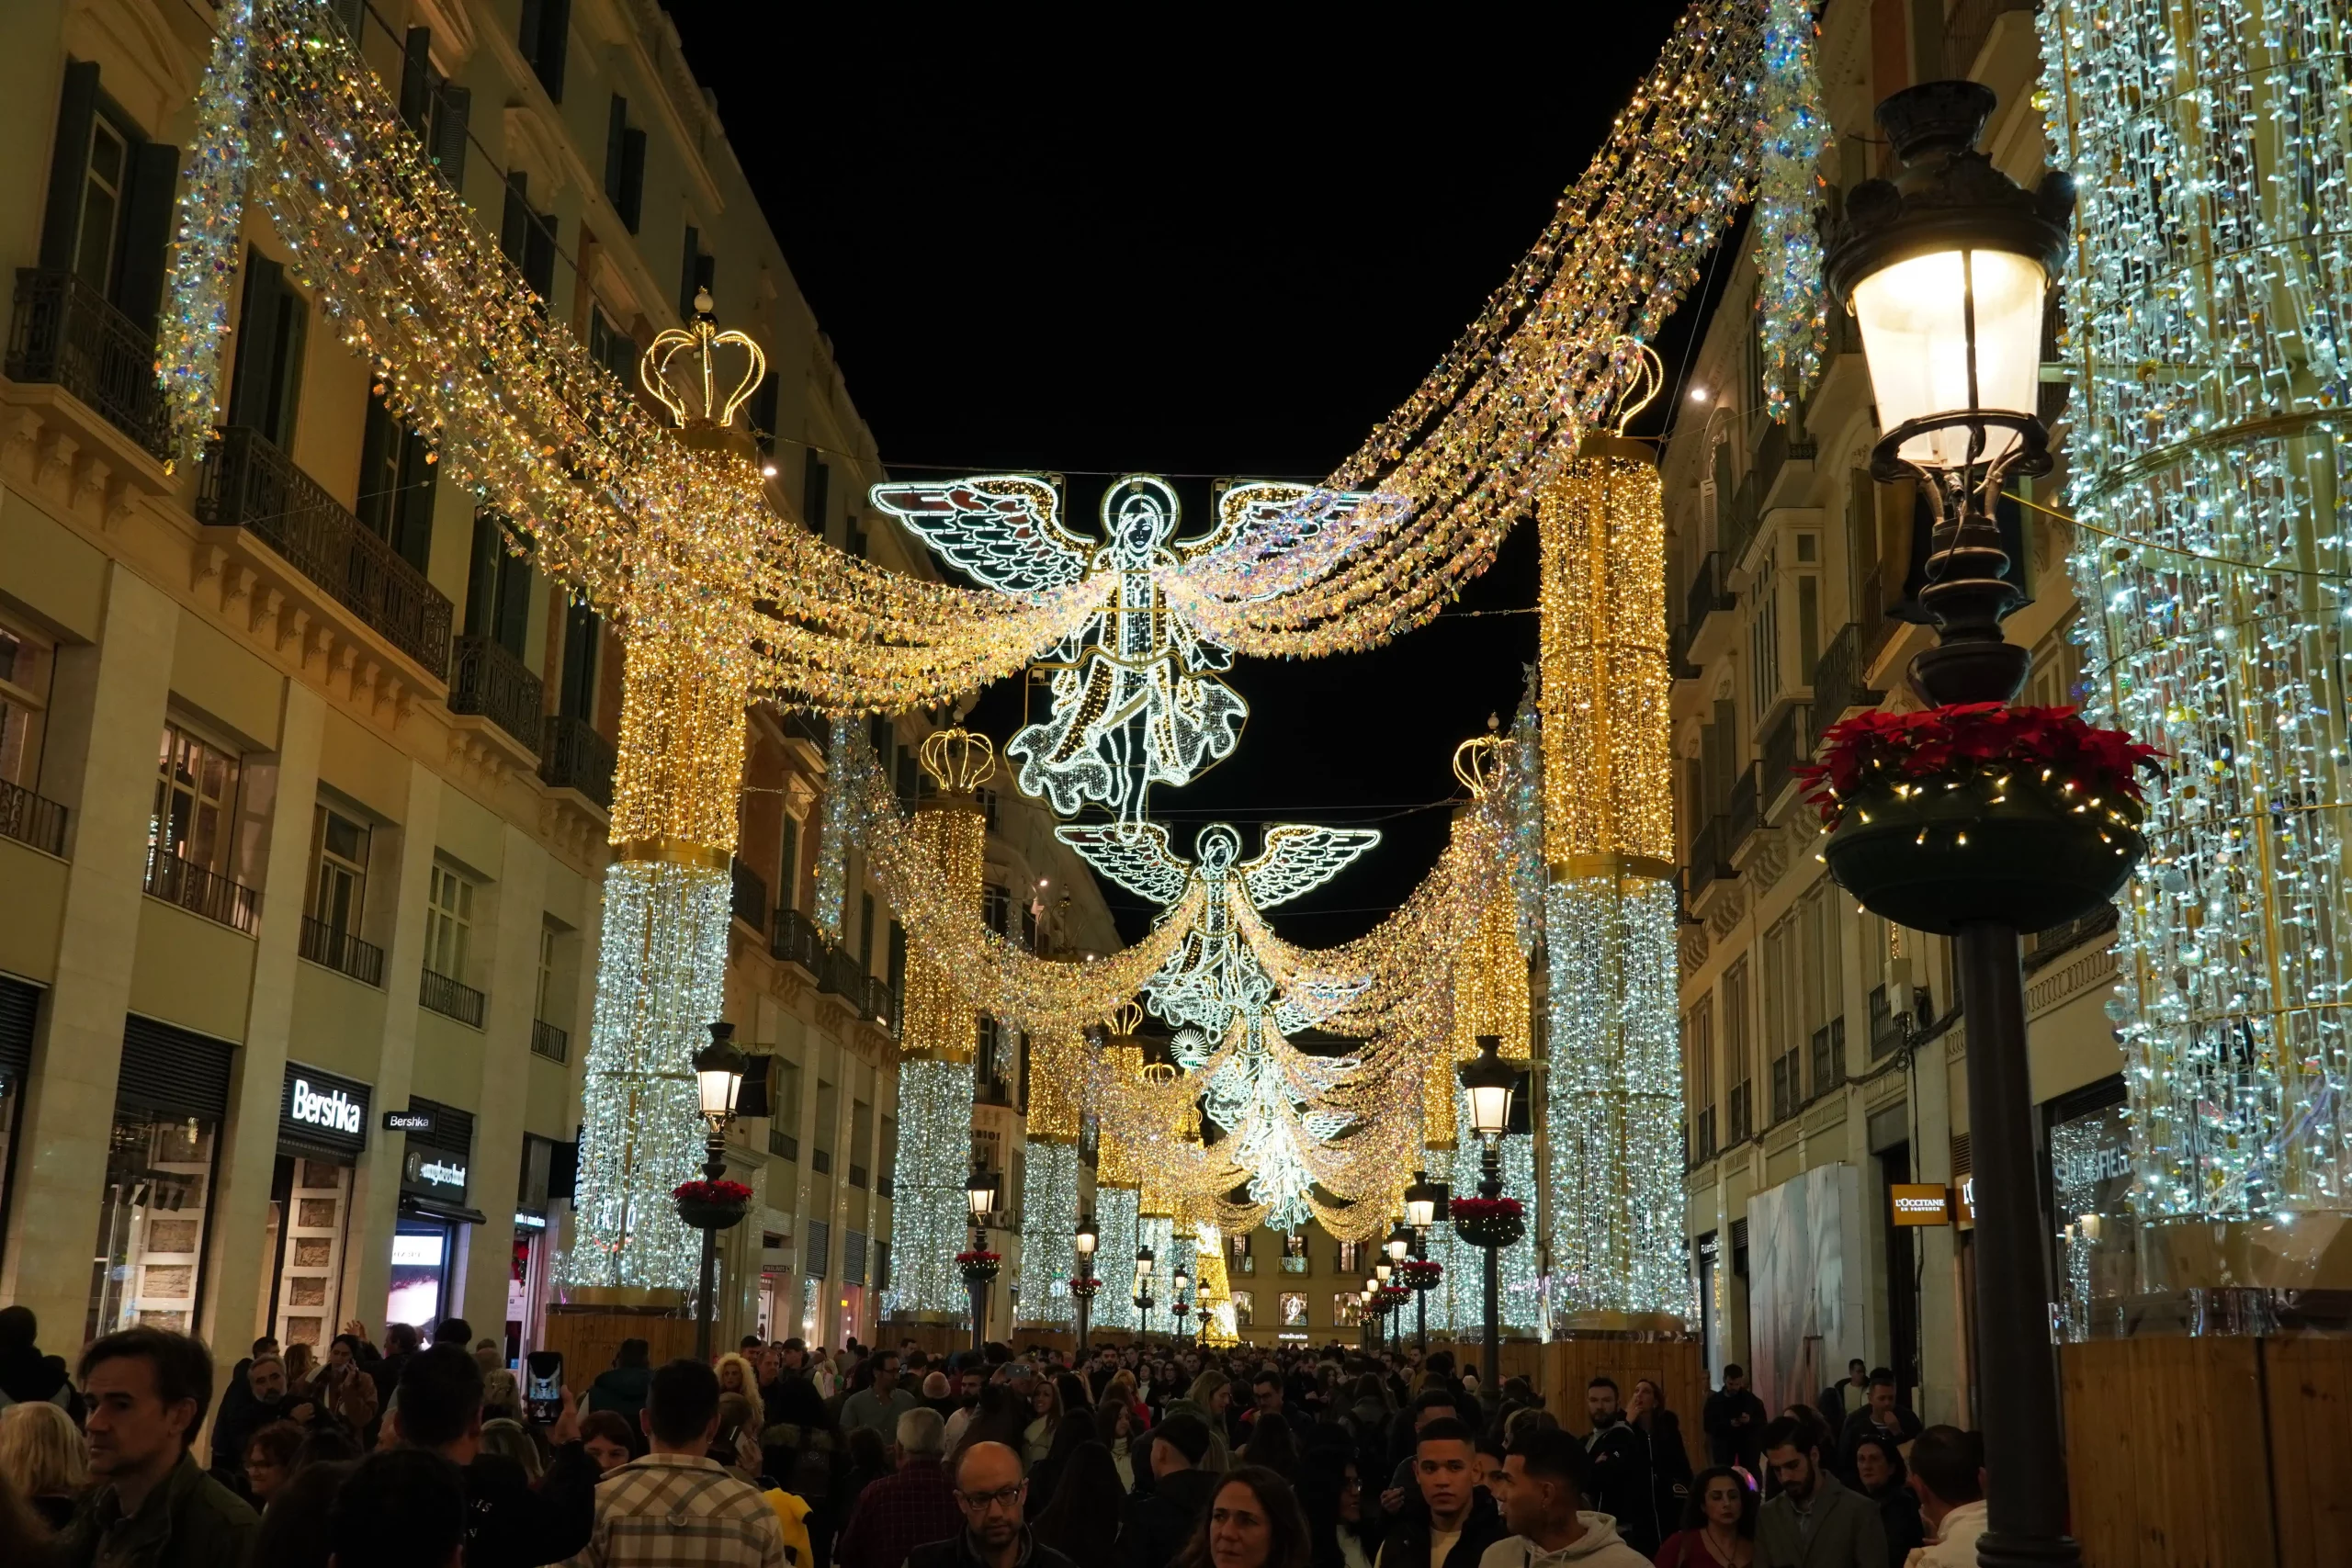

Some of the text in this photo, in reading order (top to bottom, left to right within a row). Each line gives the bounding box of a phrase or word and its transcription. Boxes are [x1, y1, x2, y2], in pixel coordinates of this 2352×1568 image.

[292, 1078, 361, 1134] Bershka
[390, 1115, 429, 1127] Bershka
[1894, 1198, 1945, 1206] L'OCCITANE
